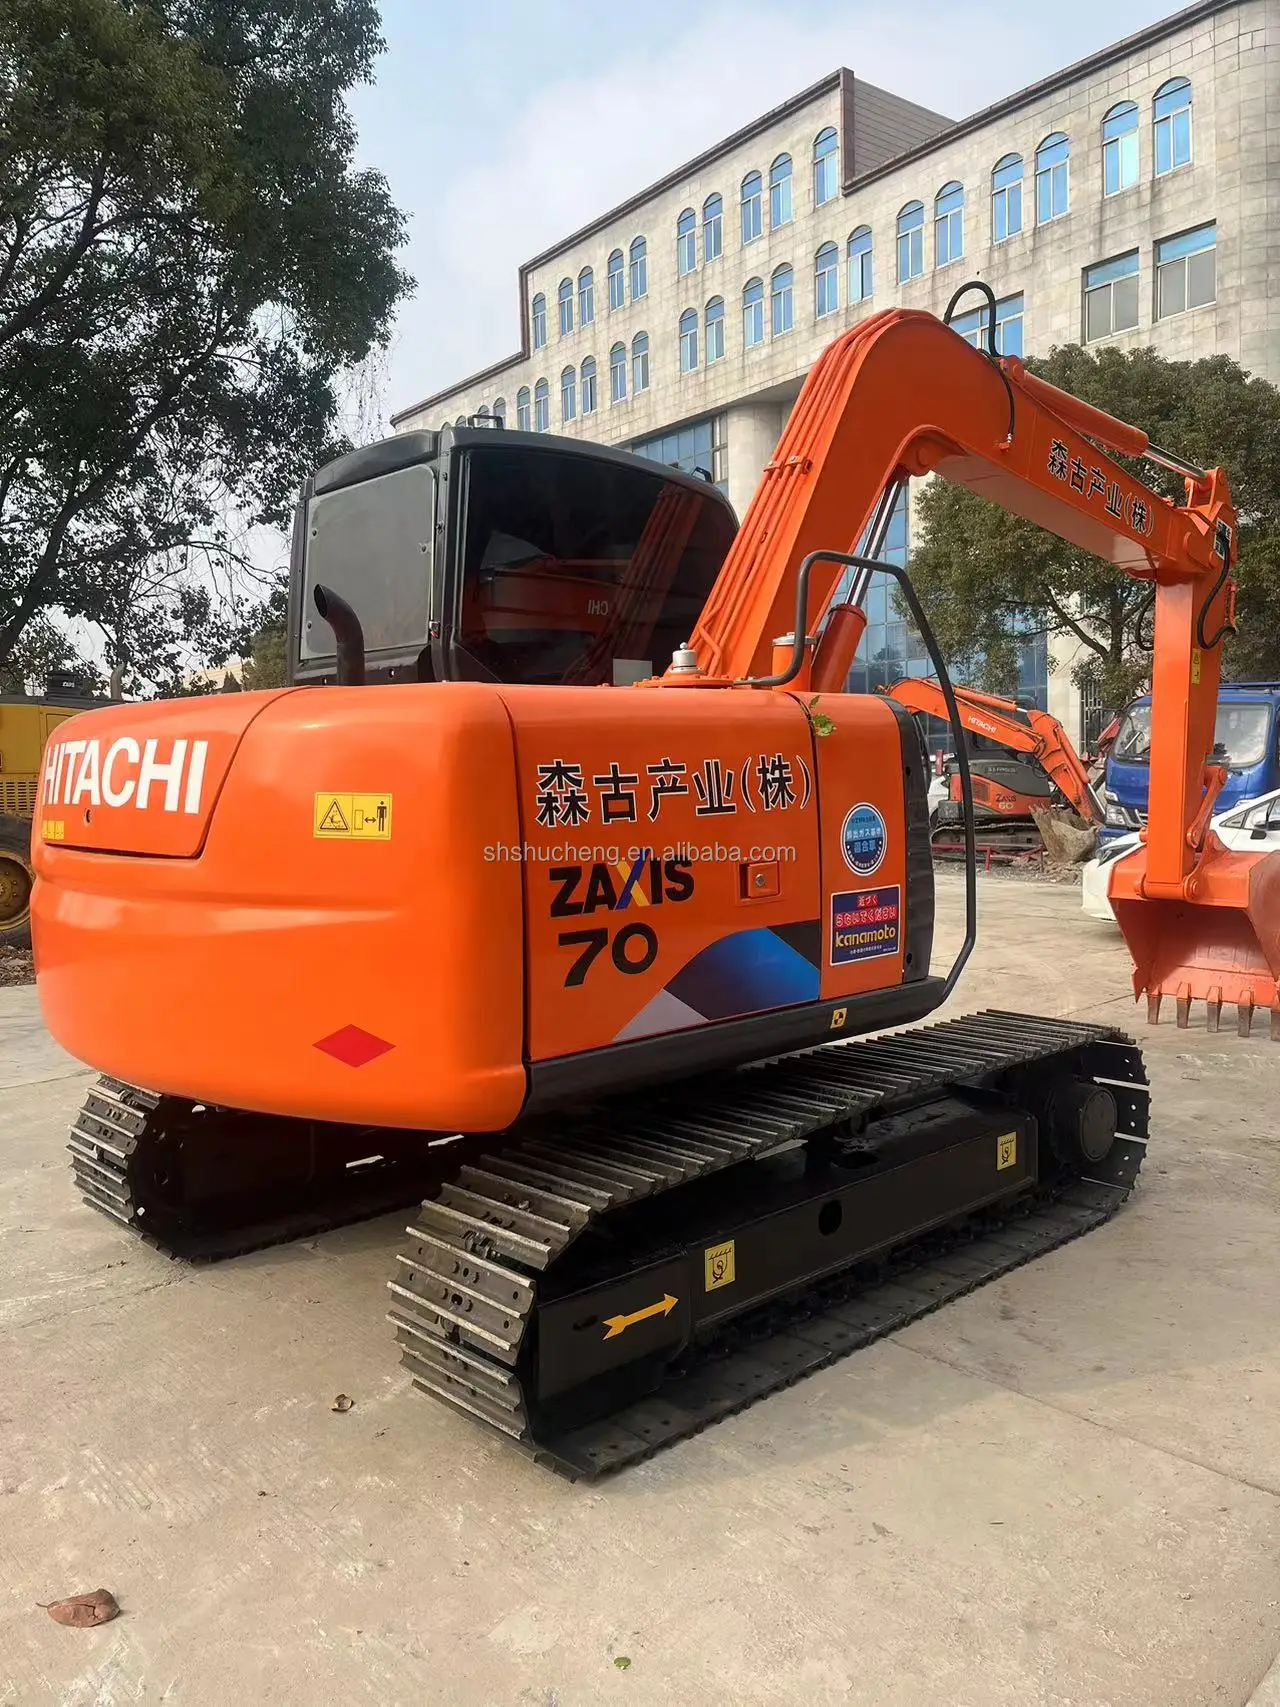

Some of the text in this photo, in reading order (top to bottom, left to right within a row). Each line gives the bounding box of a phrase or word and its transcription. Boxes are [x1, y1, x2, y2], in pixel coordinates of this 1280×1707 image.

[968, 716, 997, 733] HITACHI
[42, 737, 208, 815] HITACHI
[536, 753, 812, 828] 森古产业(株)
[550, 849, 695, 919] ZAXIS
[558, 922, 659, 988] 70
[835, 924, 896, 948] kanamoto
